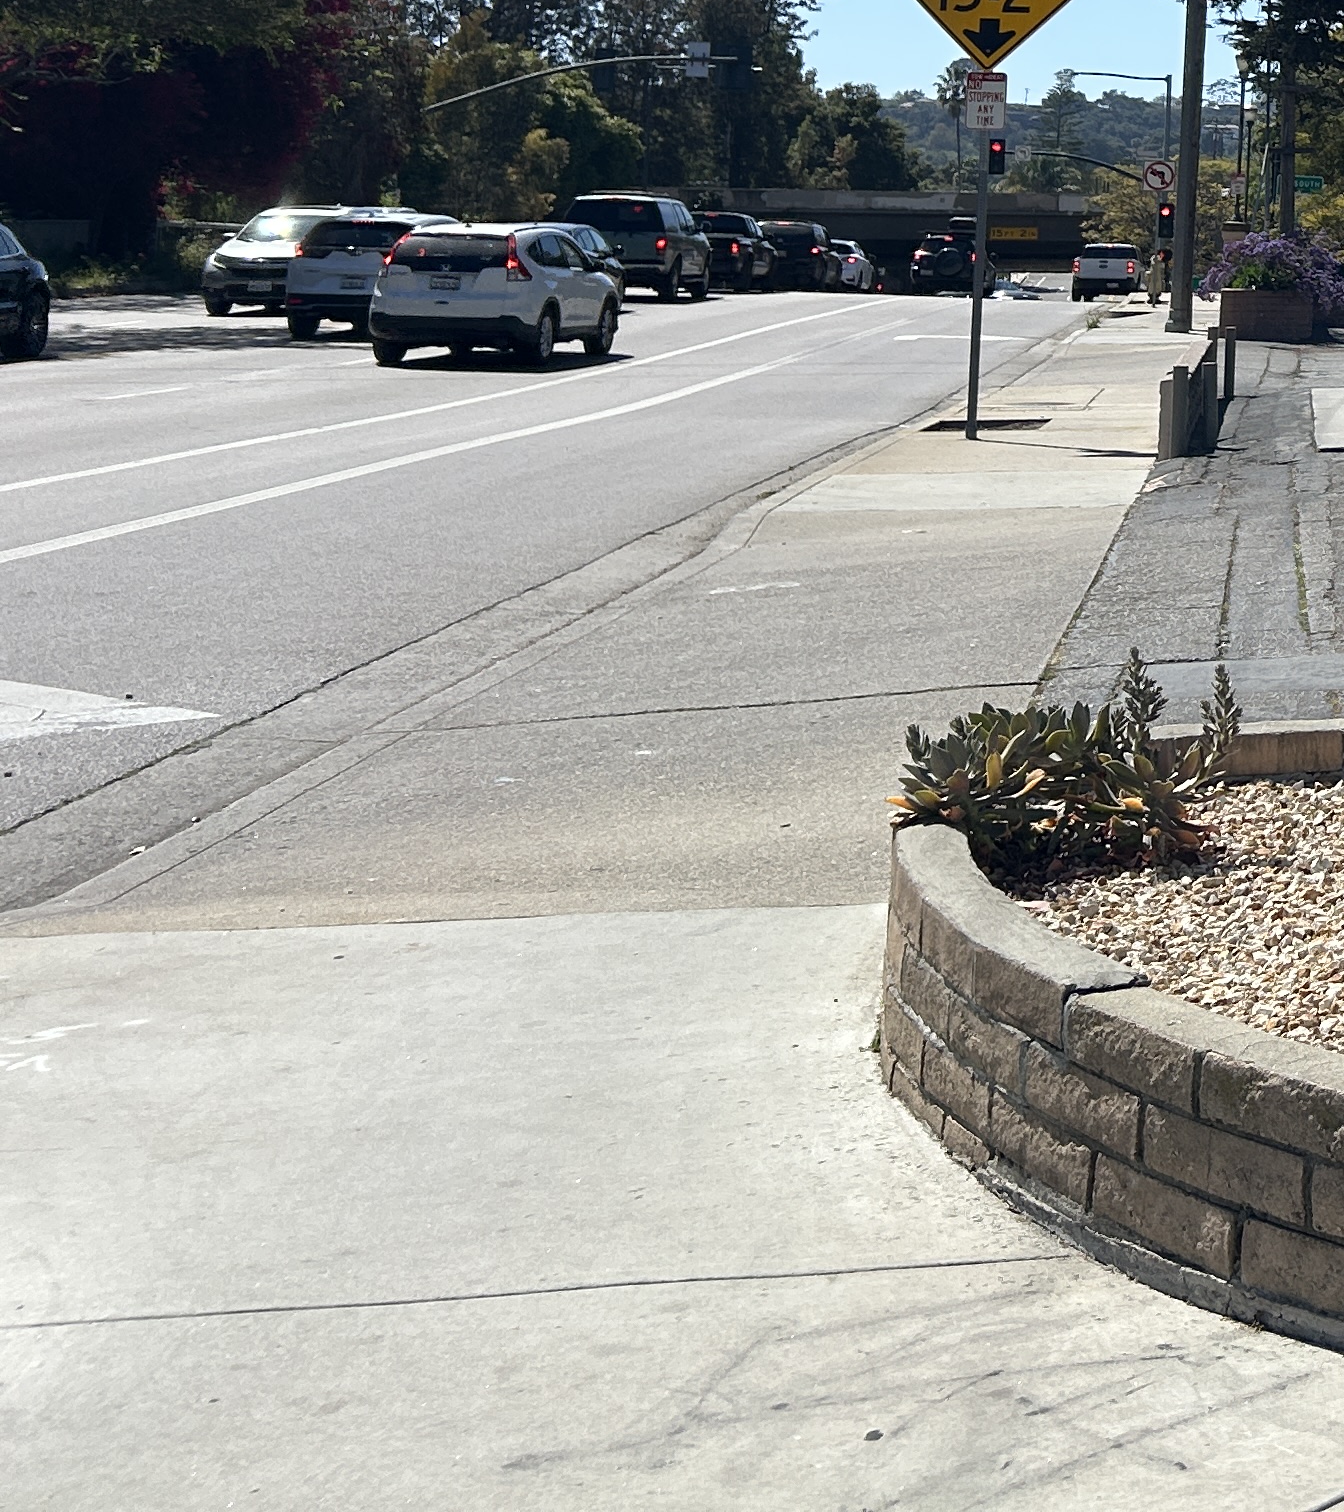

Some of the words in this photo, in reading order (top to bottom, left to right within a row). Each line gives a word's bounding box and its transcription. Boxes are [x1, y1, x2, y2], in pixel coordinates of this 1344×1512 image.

[968, 79, 983, 90] NO
[968, 91, 1005, 103] STOPPING
[977, 105, 995, 114] ANY
[976, 116, 994, 126] TIME
